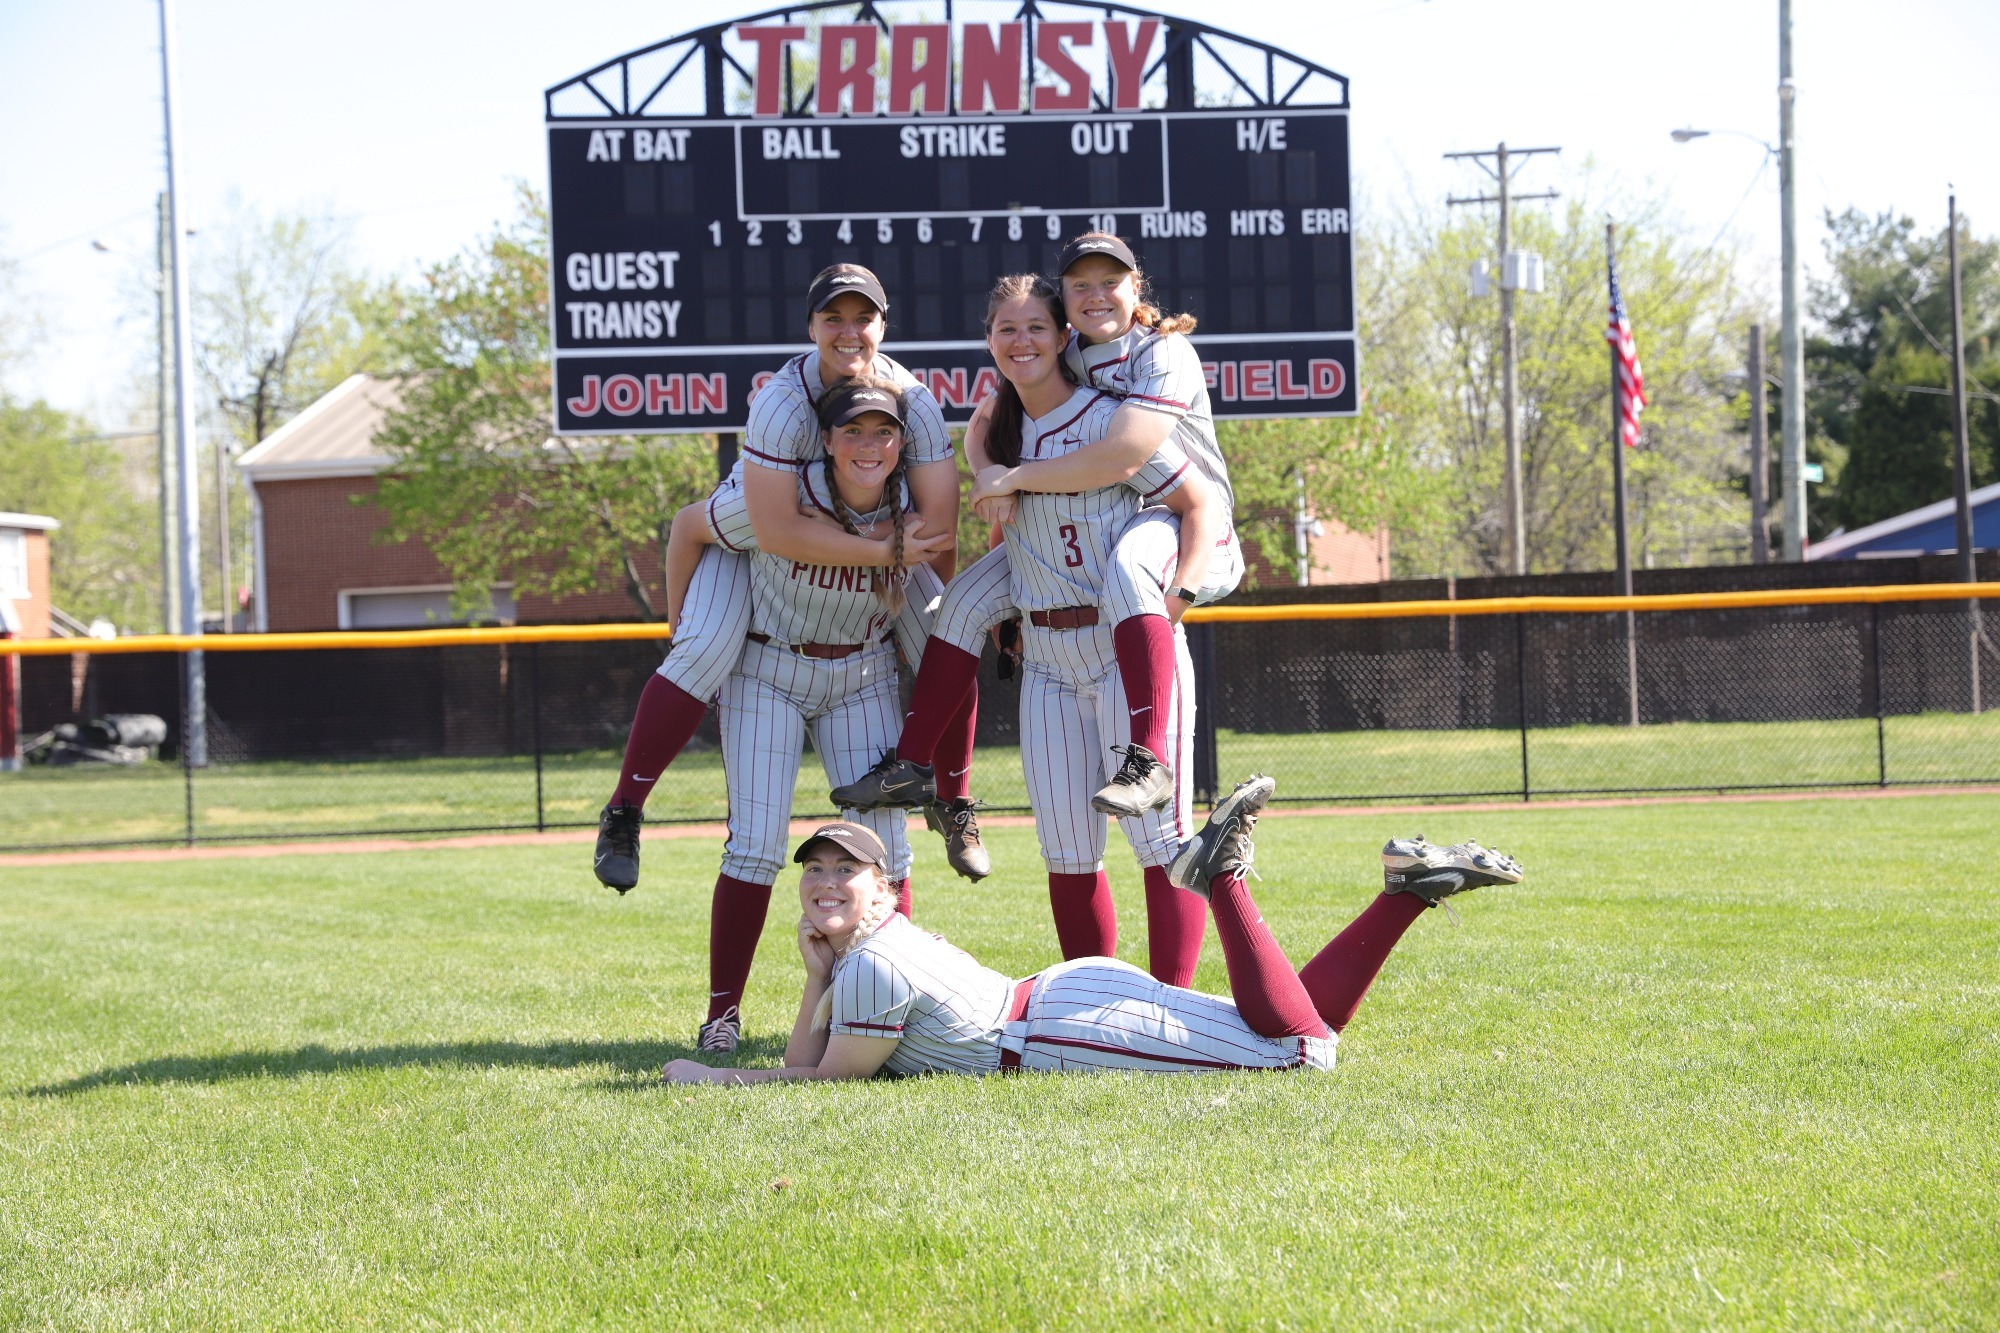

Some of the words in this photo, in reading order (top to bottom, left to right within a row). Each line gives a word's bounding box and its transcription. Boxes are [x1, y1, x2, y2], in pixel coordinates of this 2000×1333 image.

[732, 16, 1165, 119] TRANSY
[587, 129, 625, 162] AT
[633, 128, 691, 161] BAT
[762, 126, 841, 160] BALL
[900, 124, 1006, 158] STRIKE
[1071, 121, 1133, 155] OUT
[1236, 118, 1287, 153] H/E
[708, 220, 722, 247] 1
[746, 221, 763, 246] 2
[786, 220, 803, 244] 3
[837, 218, 853, 244] 4
[877, 218, 893, 243] 5
[917, 217, 933, 243] 6
[967, 217, 984, 243] 7
[1007, 216, 1023, 242] 8
[1046, 215, 1062, 241] 9
[1141, 210, 1207, 238] RUNS
[1231, 208, 1286, 236] HITS
[1302, 207, 1349, 235] ERR
[566, 251, 680, 291] GUEST
[566, 300, 682, 340] TRANSY
[567, 372, 728, 418] JOHN
[1059, 524, 1083, 568] 3
